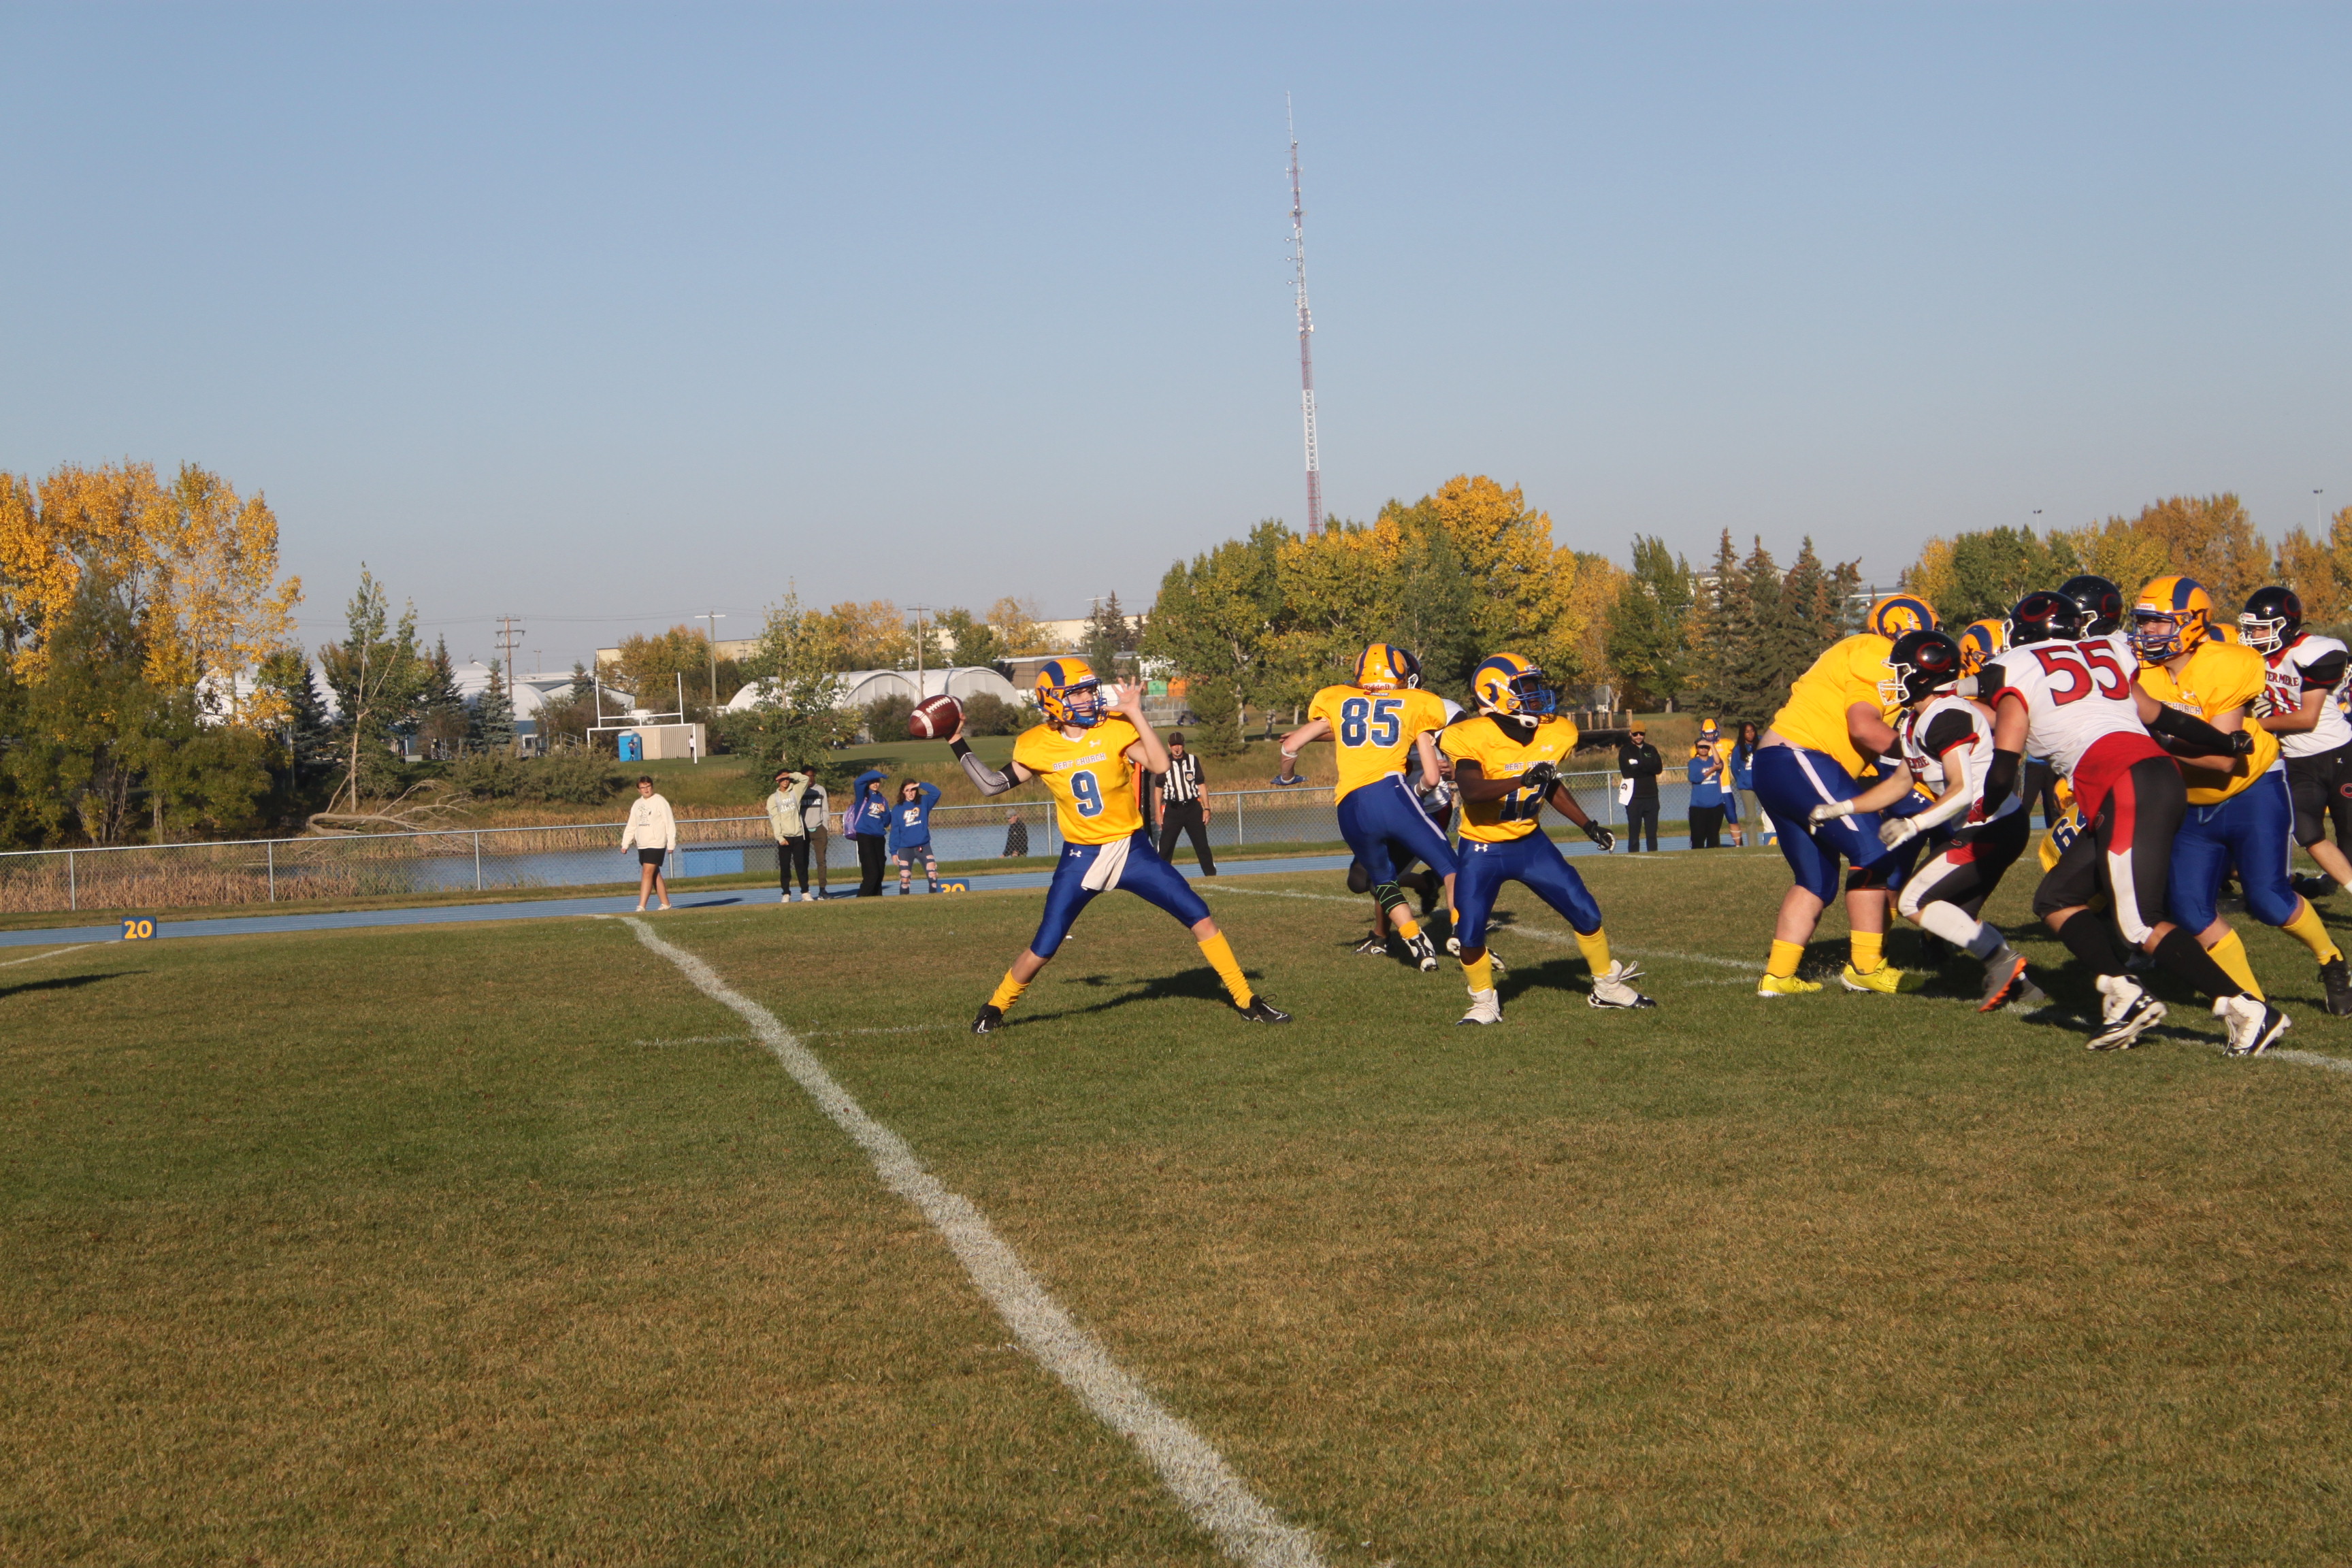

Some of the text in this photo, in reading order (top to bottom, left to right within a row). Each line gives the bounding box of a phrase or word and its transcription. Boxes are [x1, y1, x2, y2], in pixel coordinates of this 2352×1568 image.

[2030, 639, 2130, 706] 55
[1341, 697, 1405, 748] 85
[1053, 752, 1107, 771] BERT CHURCH
[1504, 762, 1524, 771] BERT
[1069, 769, 1105, 818] 9
[1499, 781, 1549, 821] 12
[124, 919, 153, 939] 20
